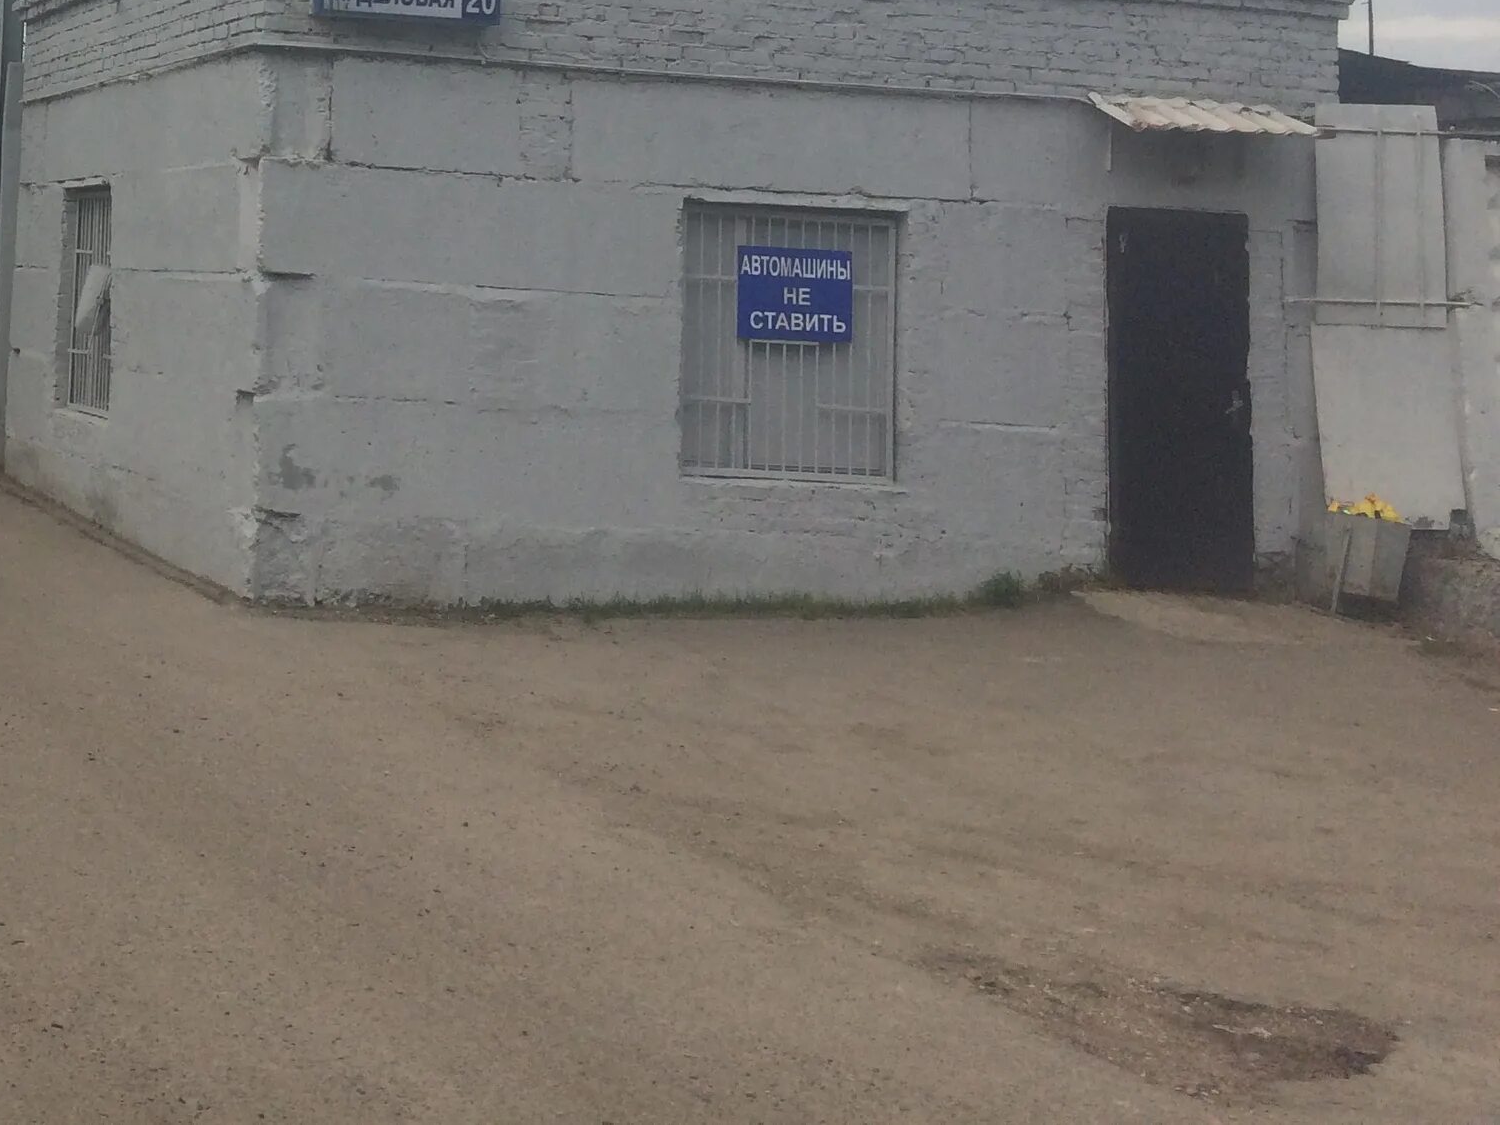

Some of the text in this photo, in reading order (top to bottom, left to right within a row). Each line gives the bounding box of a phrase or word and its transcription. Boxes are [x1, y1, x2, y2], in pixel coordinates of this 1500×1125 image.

[741, 255, 851, 280] АВТОМАШИНЫ
[783, 287, 811, 305] НЕ
[750, 311, 846, 333] СТАВИТЬ
